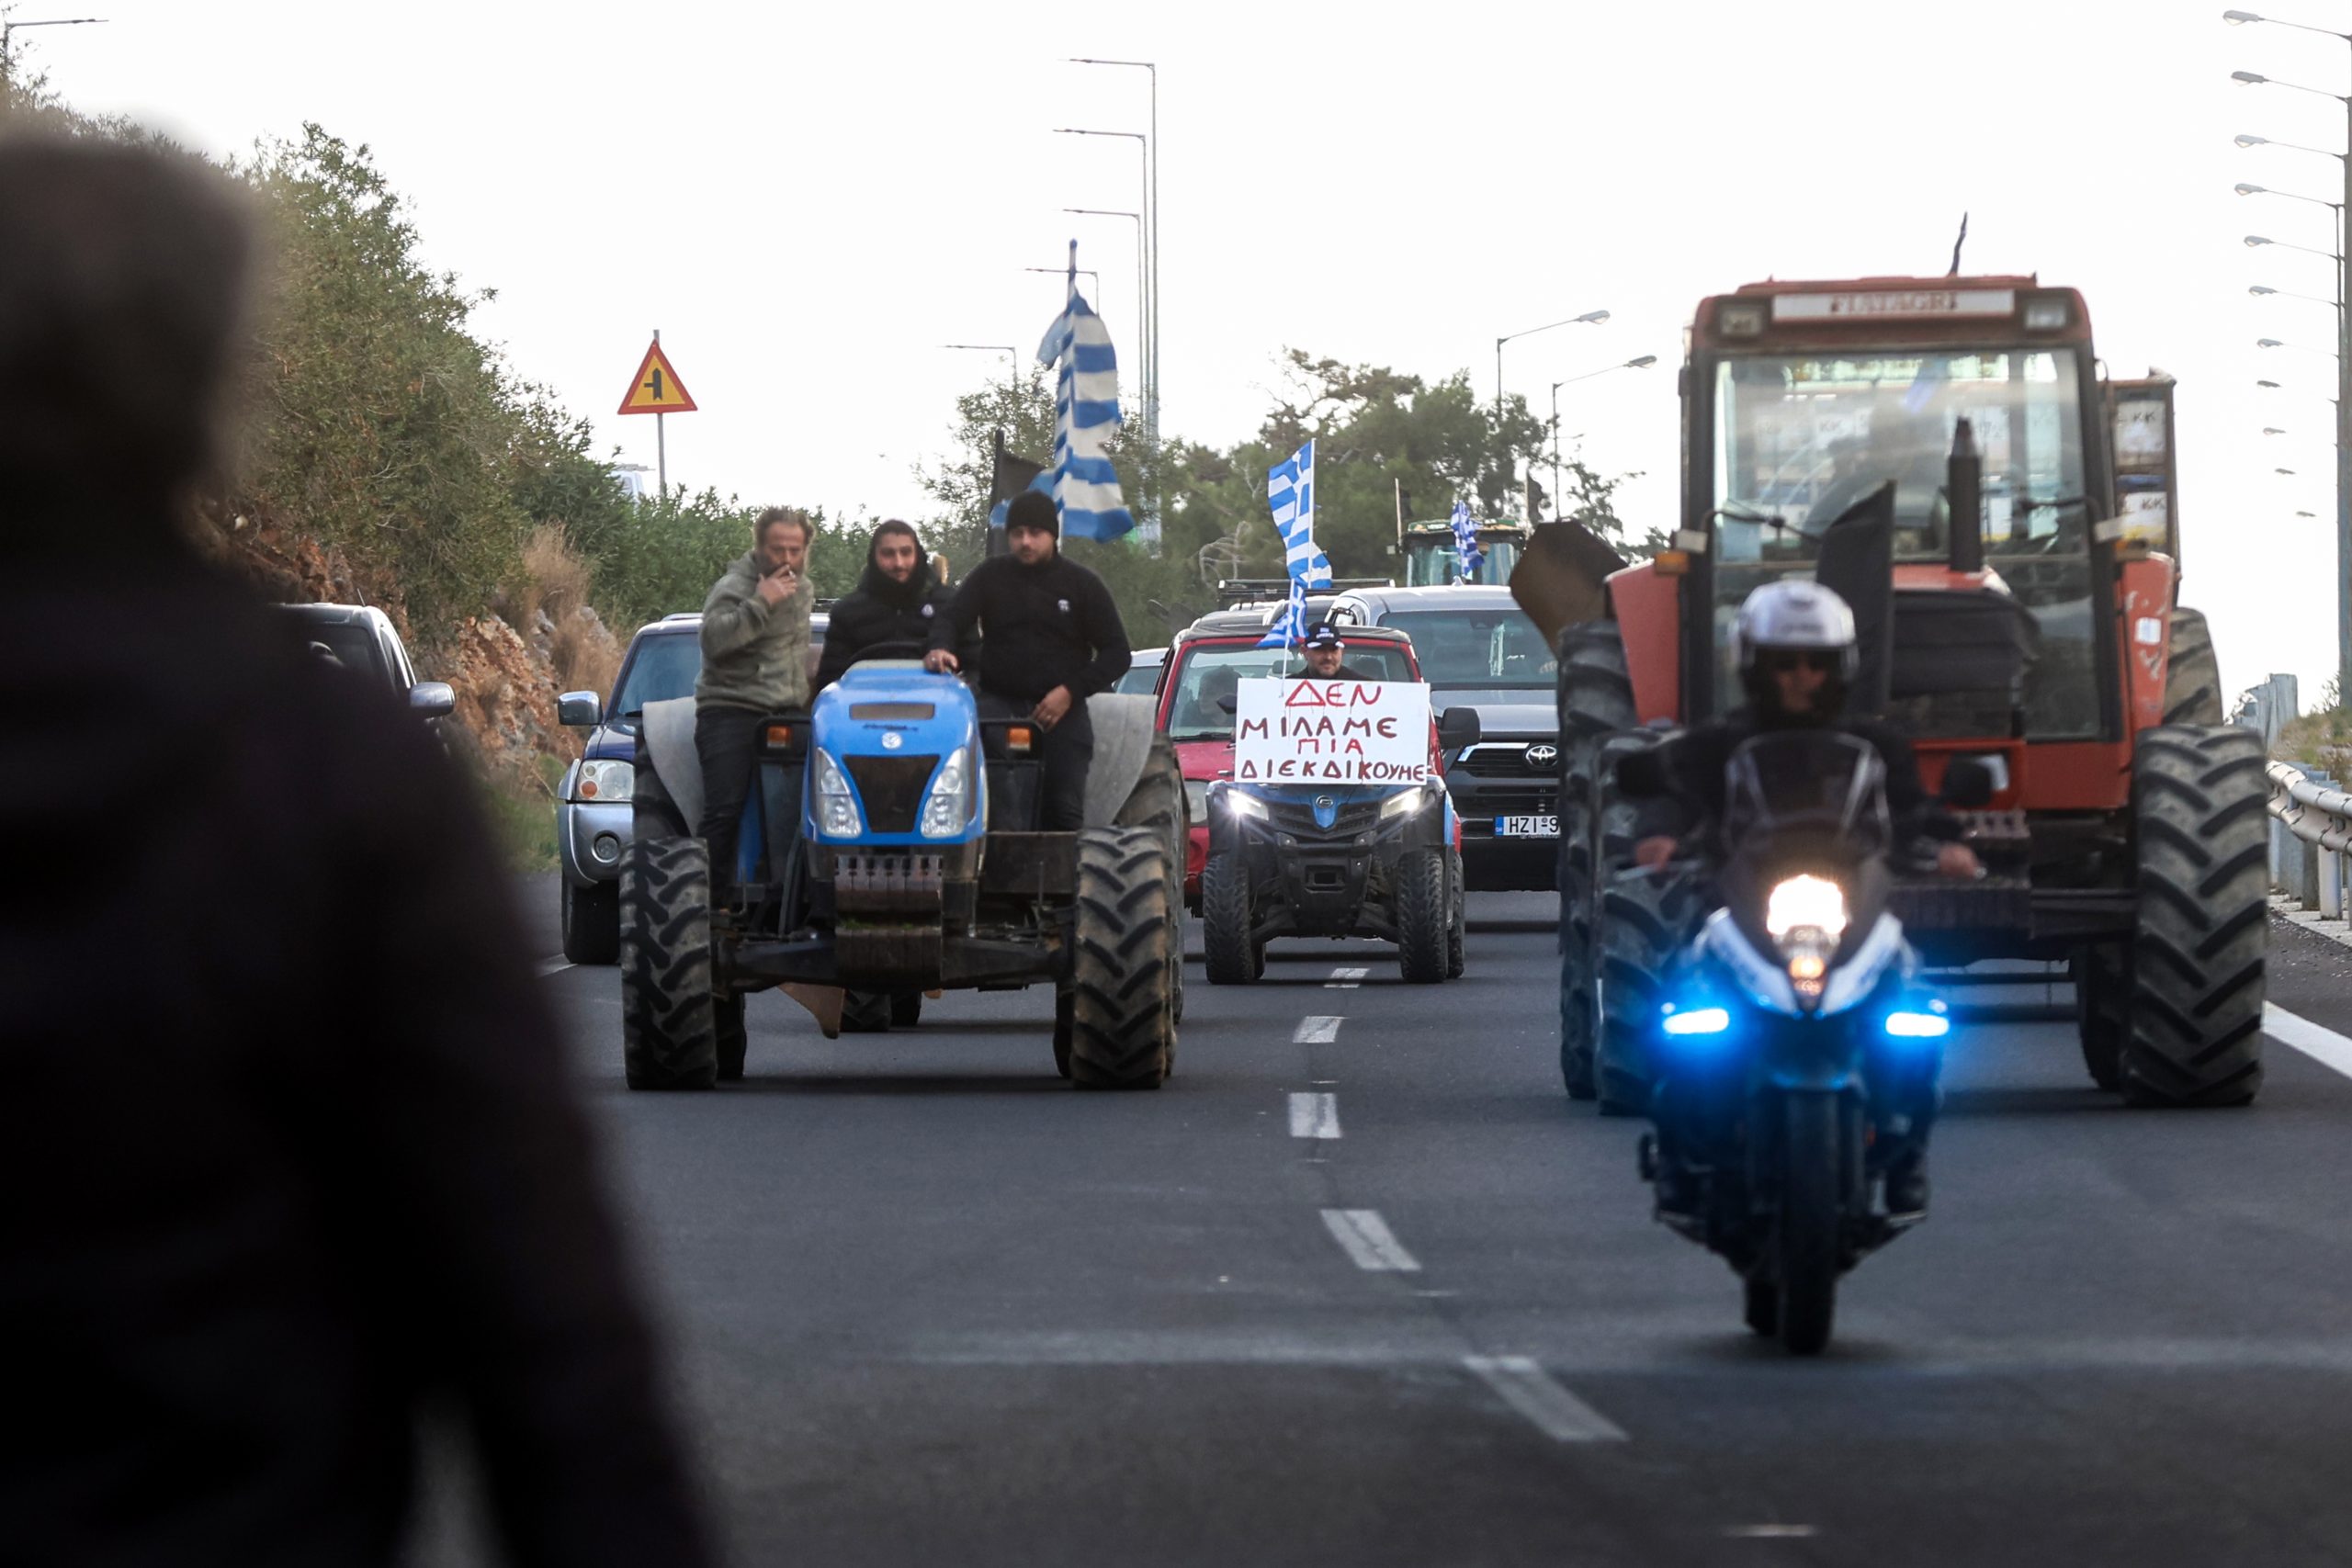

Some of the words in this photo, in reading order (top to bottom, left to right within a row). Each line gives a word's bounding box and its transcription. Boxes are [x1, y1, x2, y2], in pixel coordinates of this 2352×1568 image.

[1285, 680, 1382, 707] ΔΕΝ
[1240, 716, 1397, 739] ΜΙΛΑΜΕ
[1297, 738, 1363, 755] ΠΙΑ
